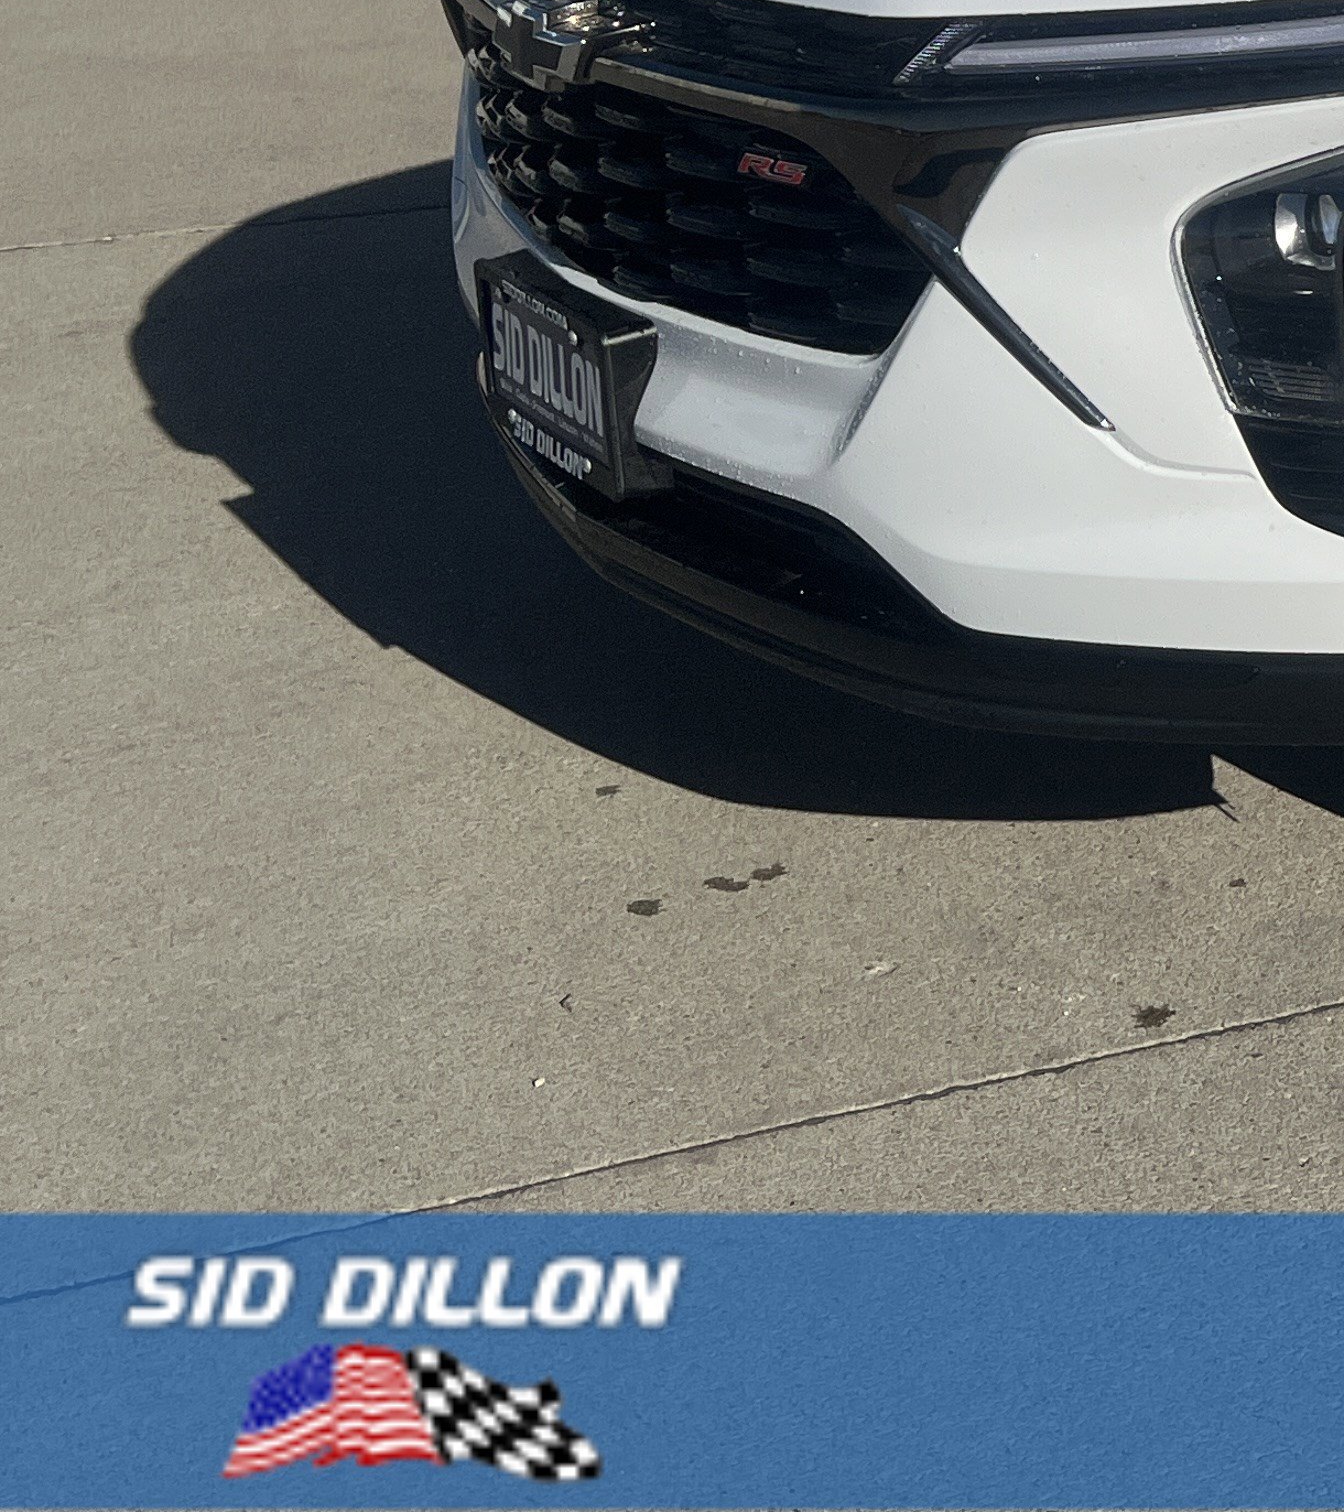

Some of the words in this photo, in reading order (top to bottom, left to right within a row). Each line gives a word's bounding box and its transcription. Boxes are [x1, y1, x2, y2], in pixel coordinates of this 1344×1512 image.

[737, 152, 808, 185] RS
[491, 302, 526, 386] SID
[526, 324, 605, 439] DILLON
[512, 416, 535, 448] SID
[536, 428, 586, 481] DILLON
